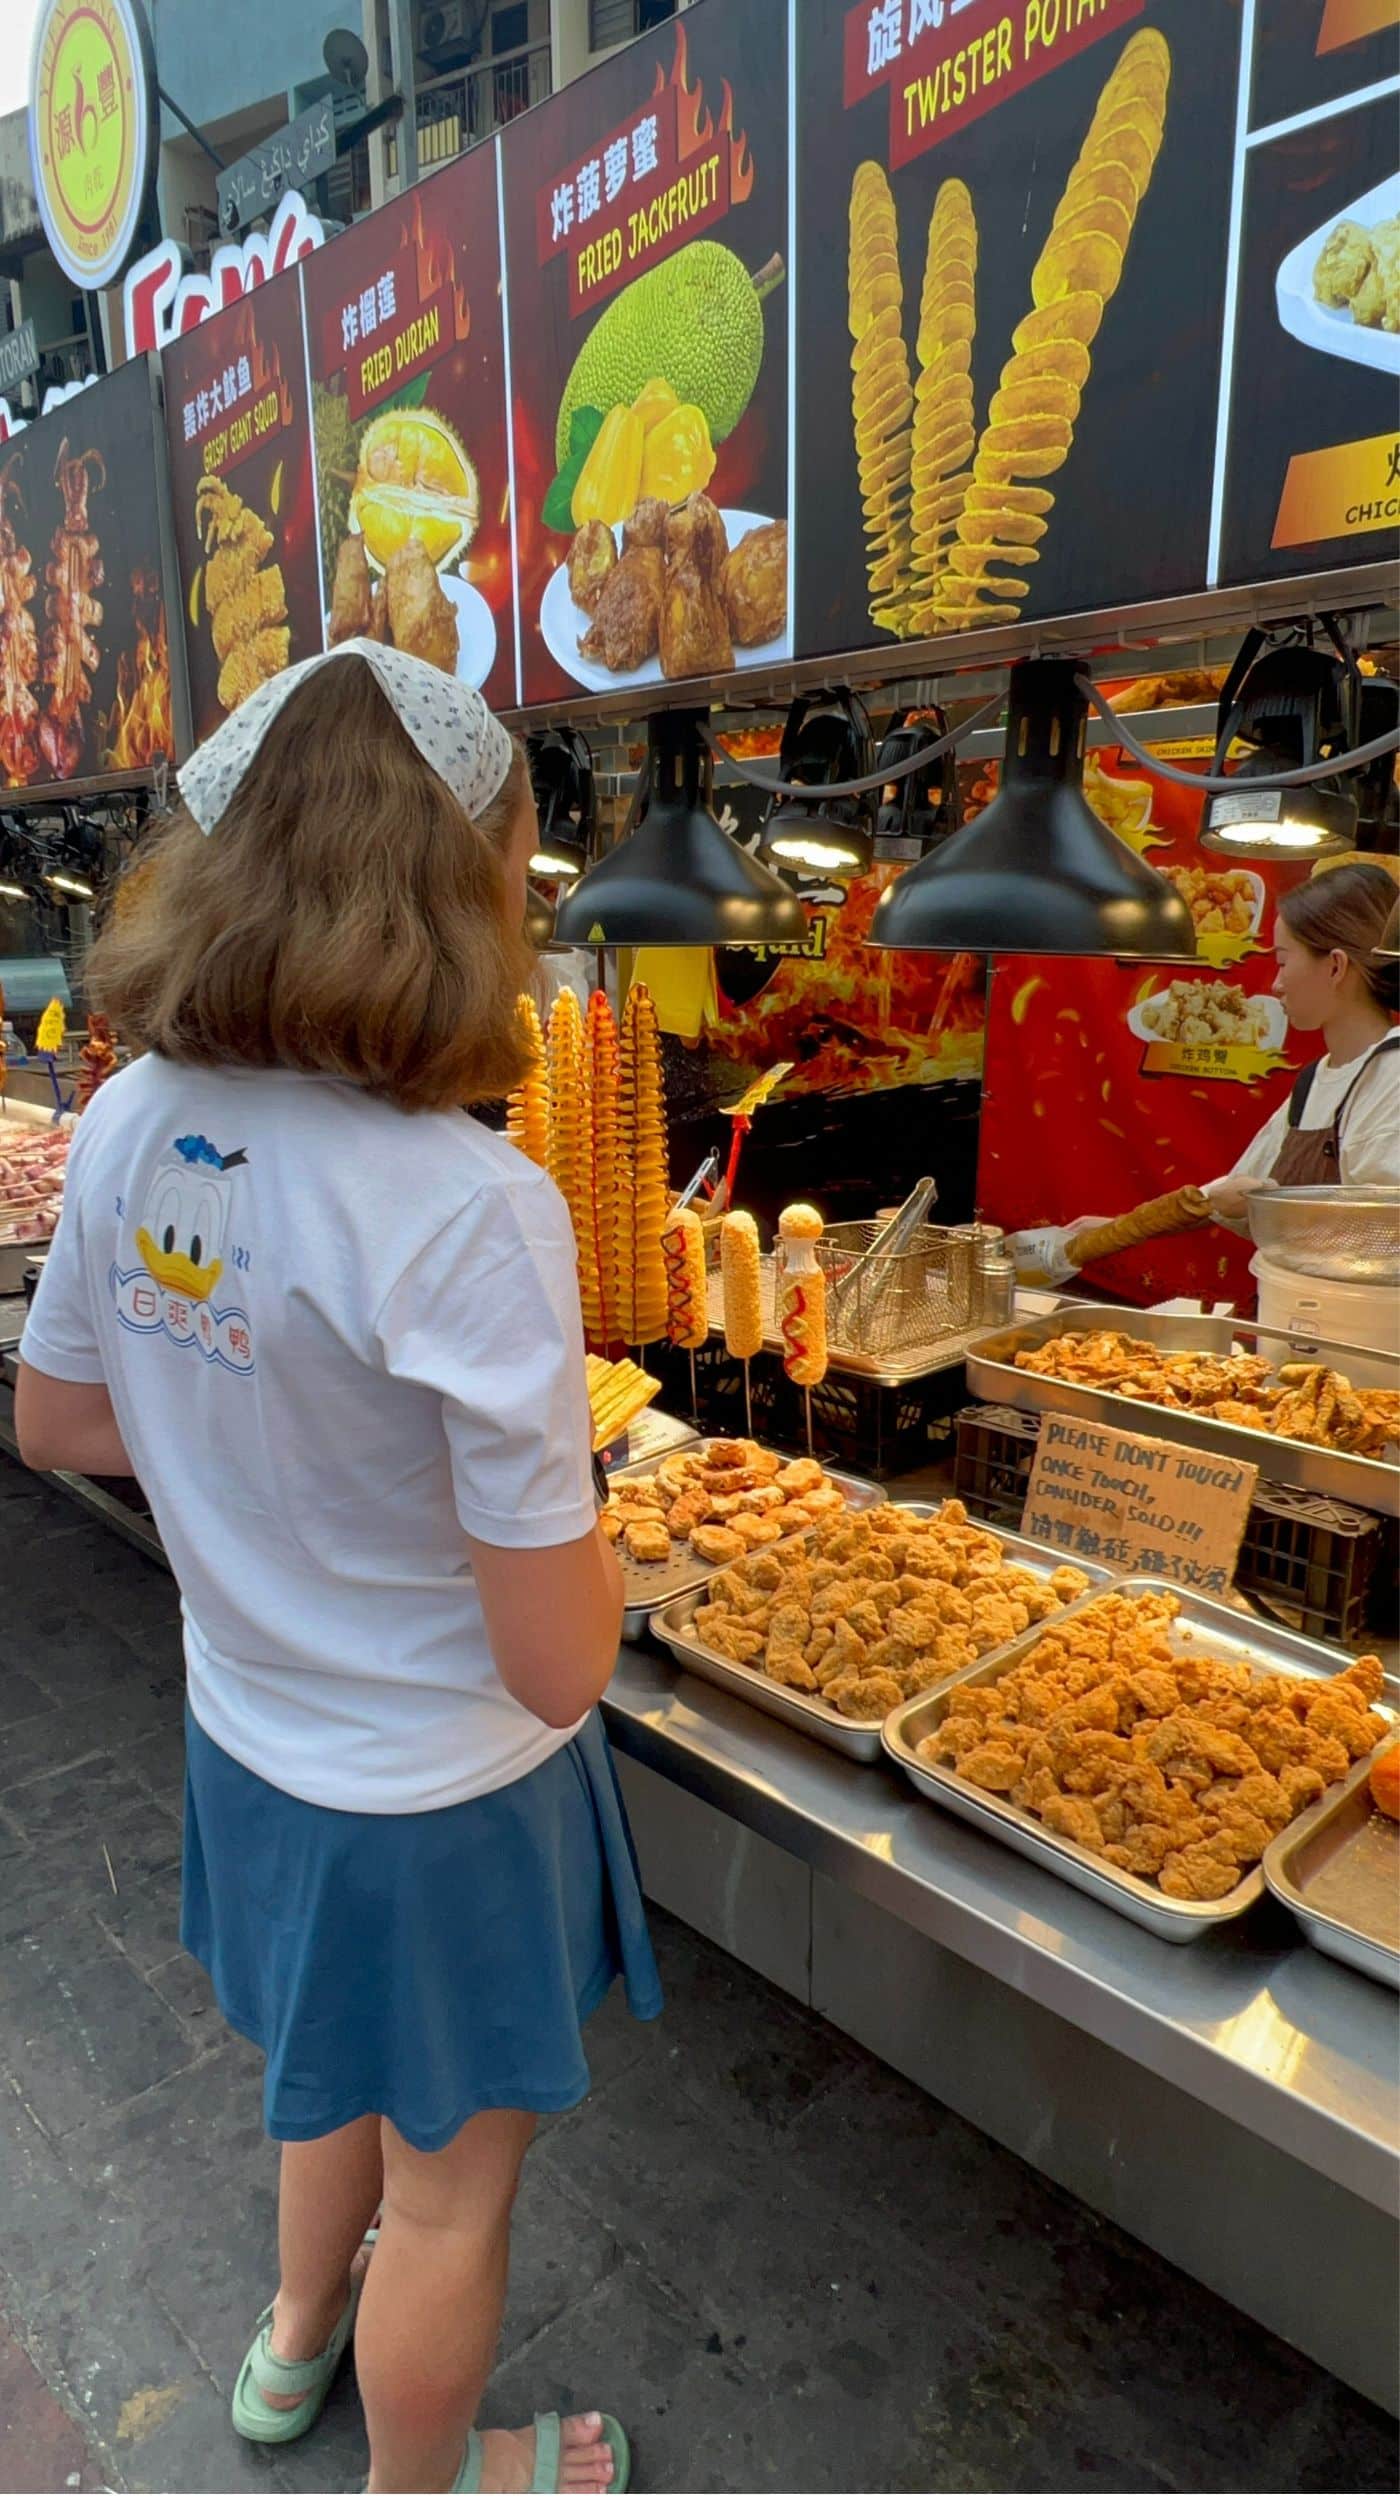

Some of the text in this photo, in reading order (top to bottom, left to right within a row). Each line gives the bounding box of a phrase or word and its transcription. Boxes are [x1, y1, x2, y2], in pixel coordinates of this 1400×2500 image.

[867, 0, 974, 76] 旋风
[904, 17, 1012, 136] TWISTER
[551, 114, 658, 242] 炸菠萝蜜
[578, 154, 720, 294] FRIED JACKFRUIT
[361, 304, 439, 396] FRIED DURIAN
[230, 411, 252, 454] GIANT
[254, 391, 279, 436] SQUID
[1345, 498, 1400, 525] CHIC
[1047, 1423, 1244, 1493] PLEASE DON'T TOUCH
[1035, 1480, 1120, 1520] CONSIDER
